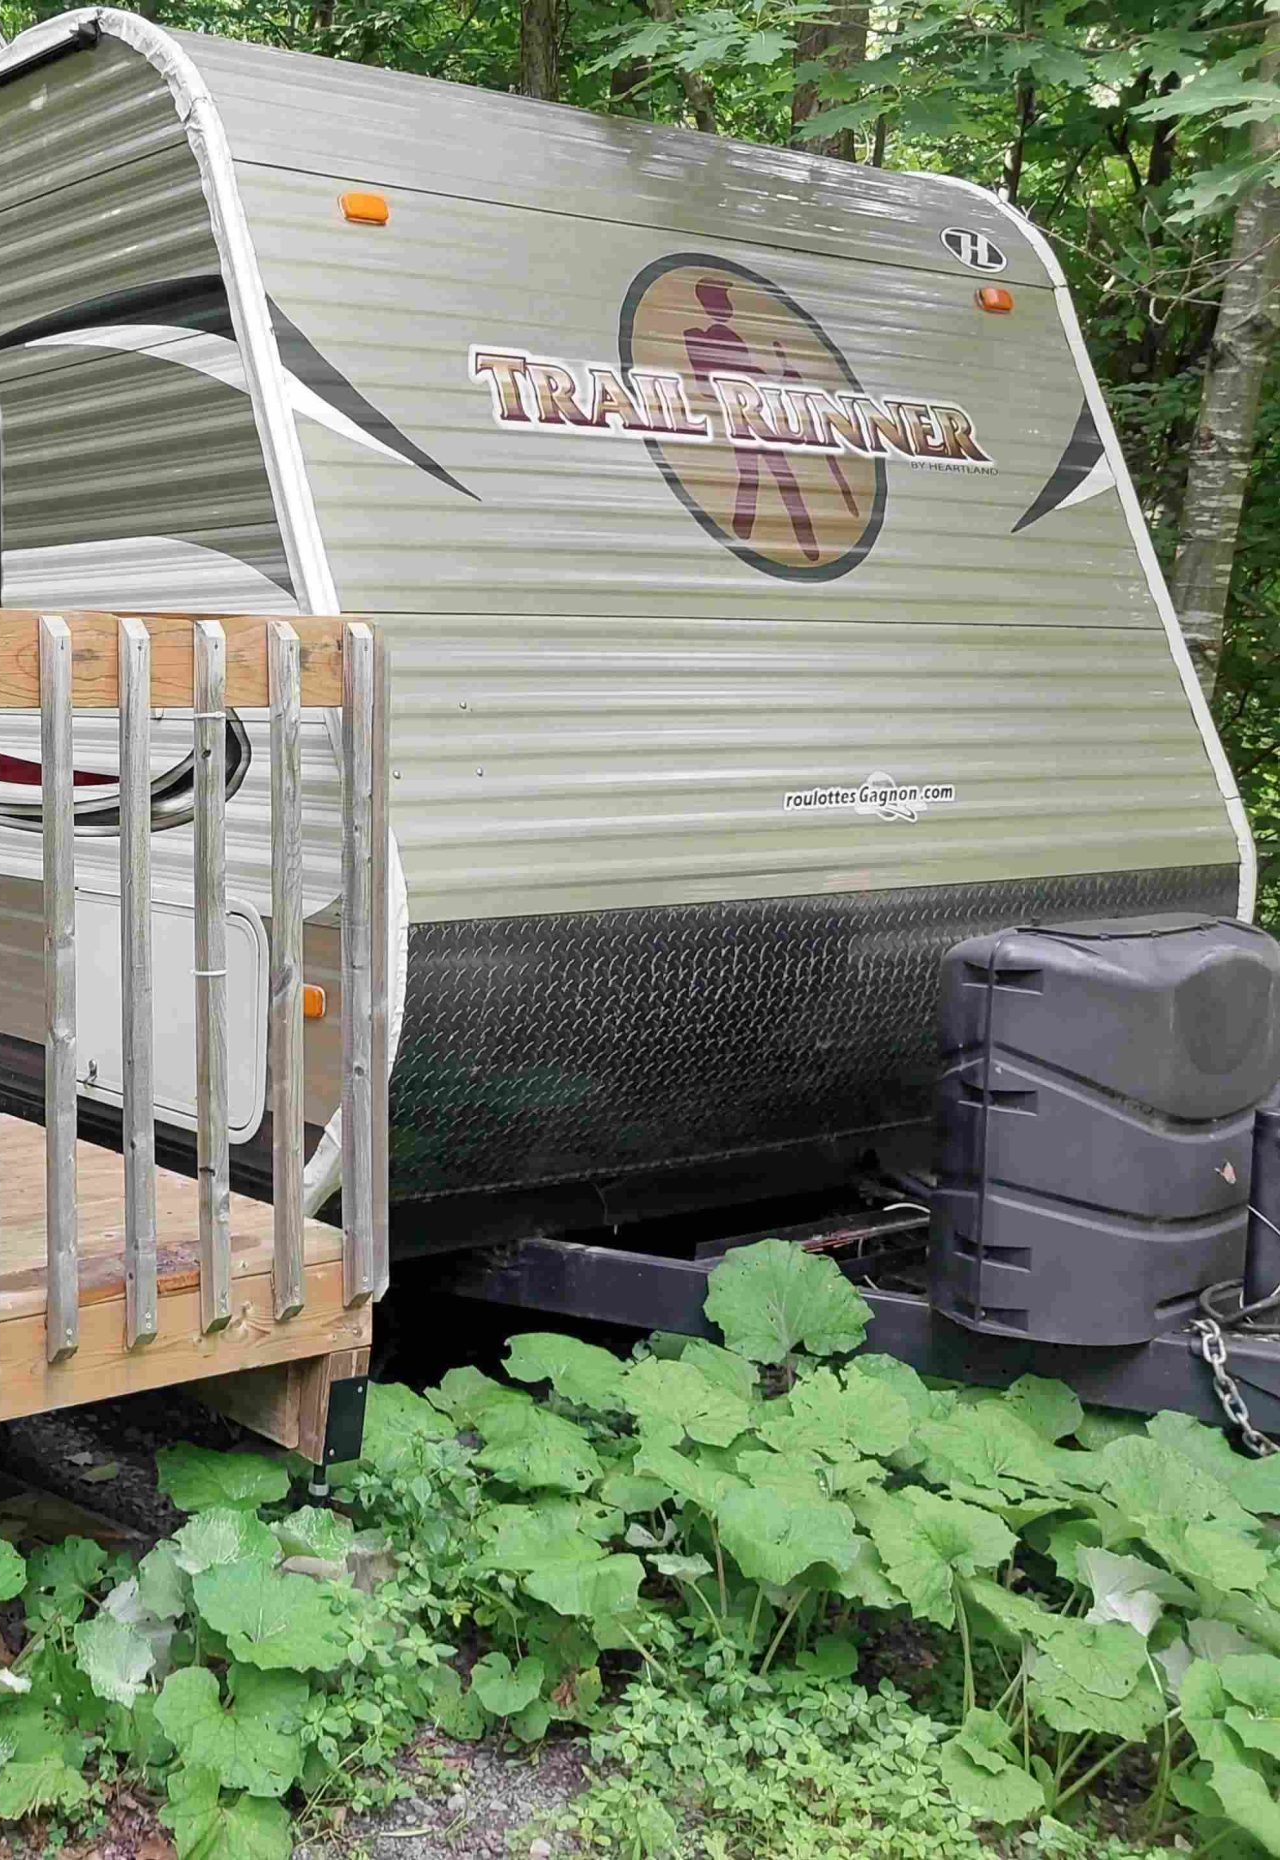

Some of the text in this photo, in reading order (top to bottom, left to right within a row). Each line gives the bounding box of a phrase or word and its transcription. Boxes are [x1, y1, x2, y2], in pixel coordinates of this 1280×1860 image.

[475, 352, 993, 462] TRAIL RUNNER
[910, 460, 999, 477] BY HEARTLAND
